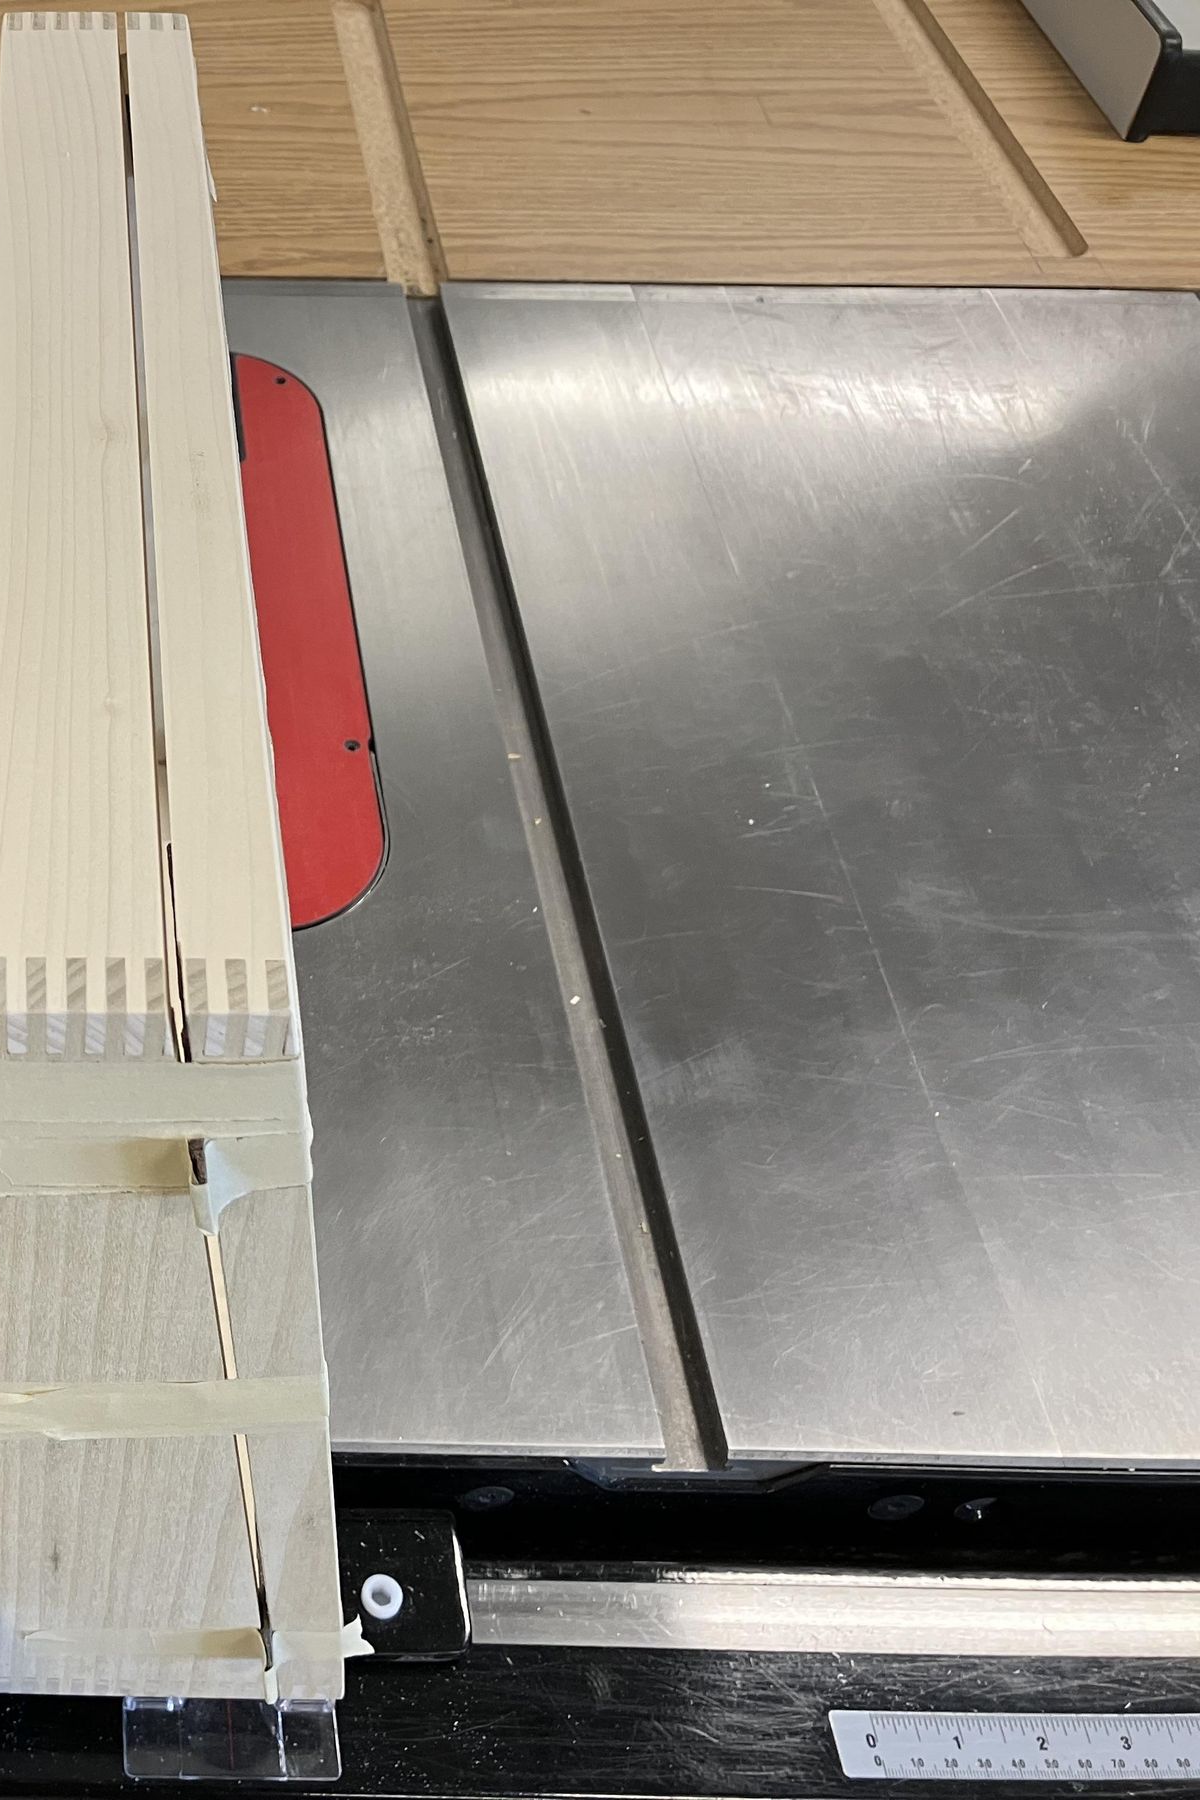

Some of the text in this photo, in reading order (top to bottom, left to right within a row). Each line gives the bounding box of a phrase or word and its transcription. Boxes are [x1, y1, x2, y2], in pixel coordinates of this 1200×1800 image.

[866, 1733, 1132, 1751] 0 1 2 3
[874, 1755, 1190, 1768] 0 10 20 30 40 50 60 70 80 90
